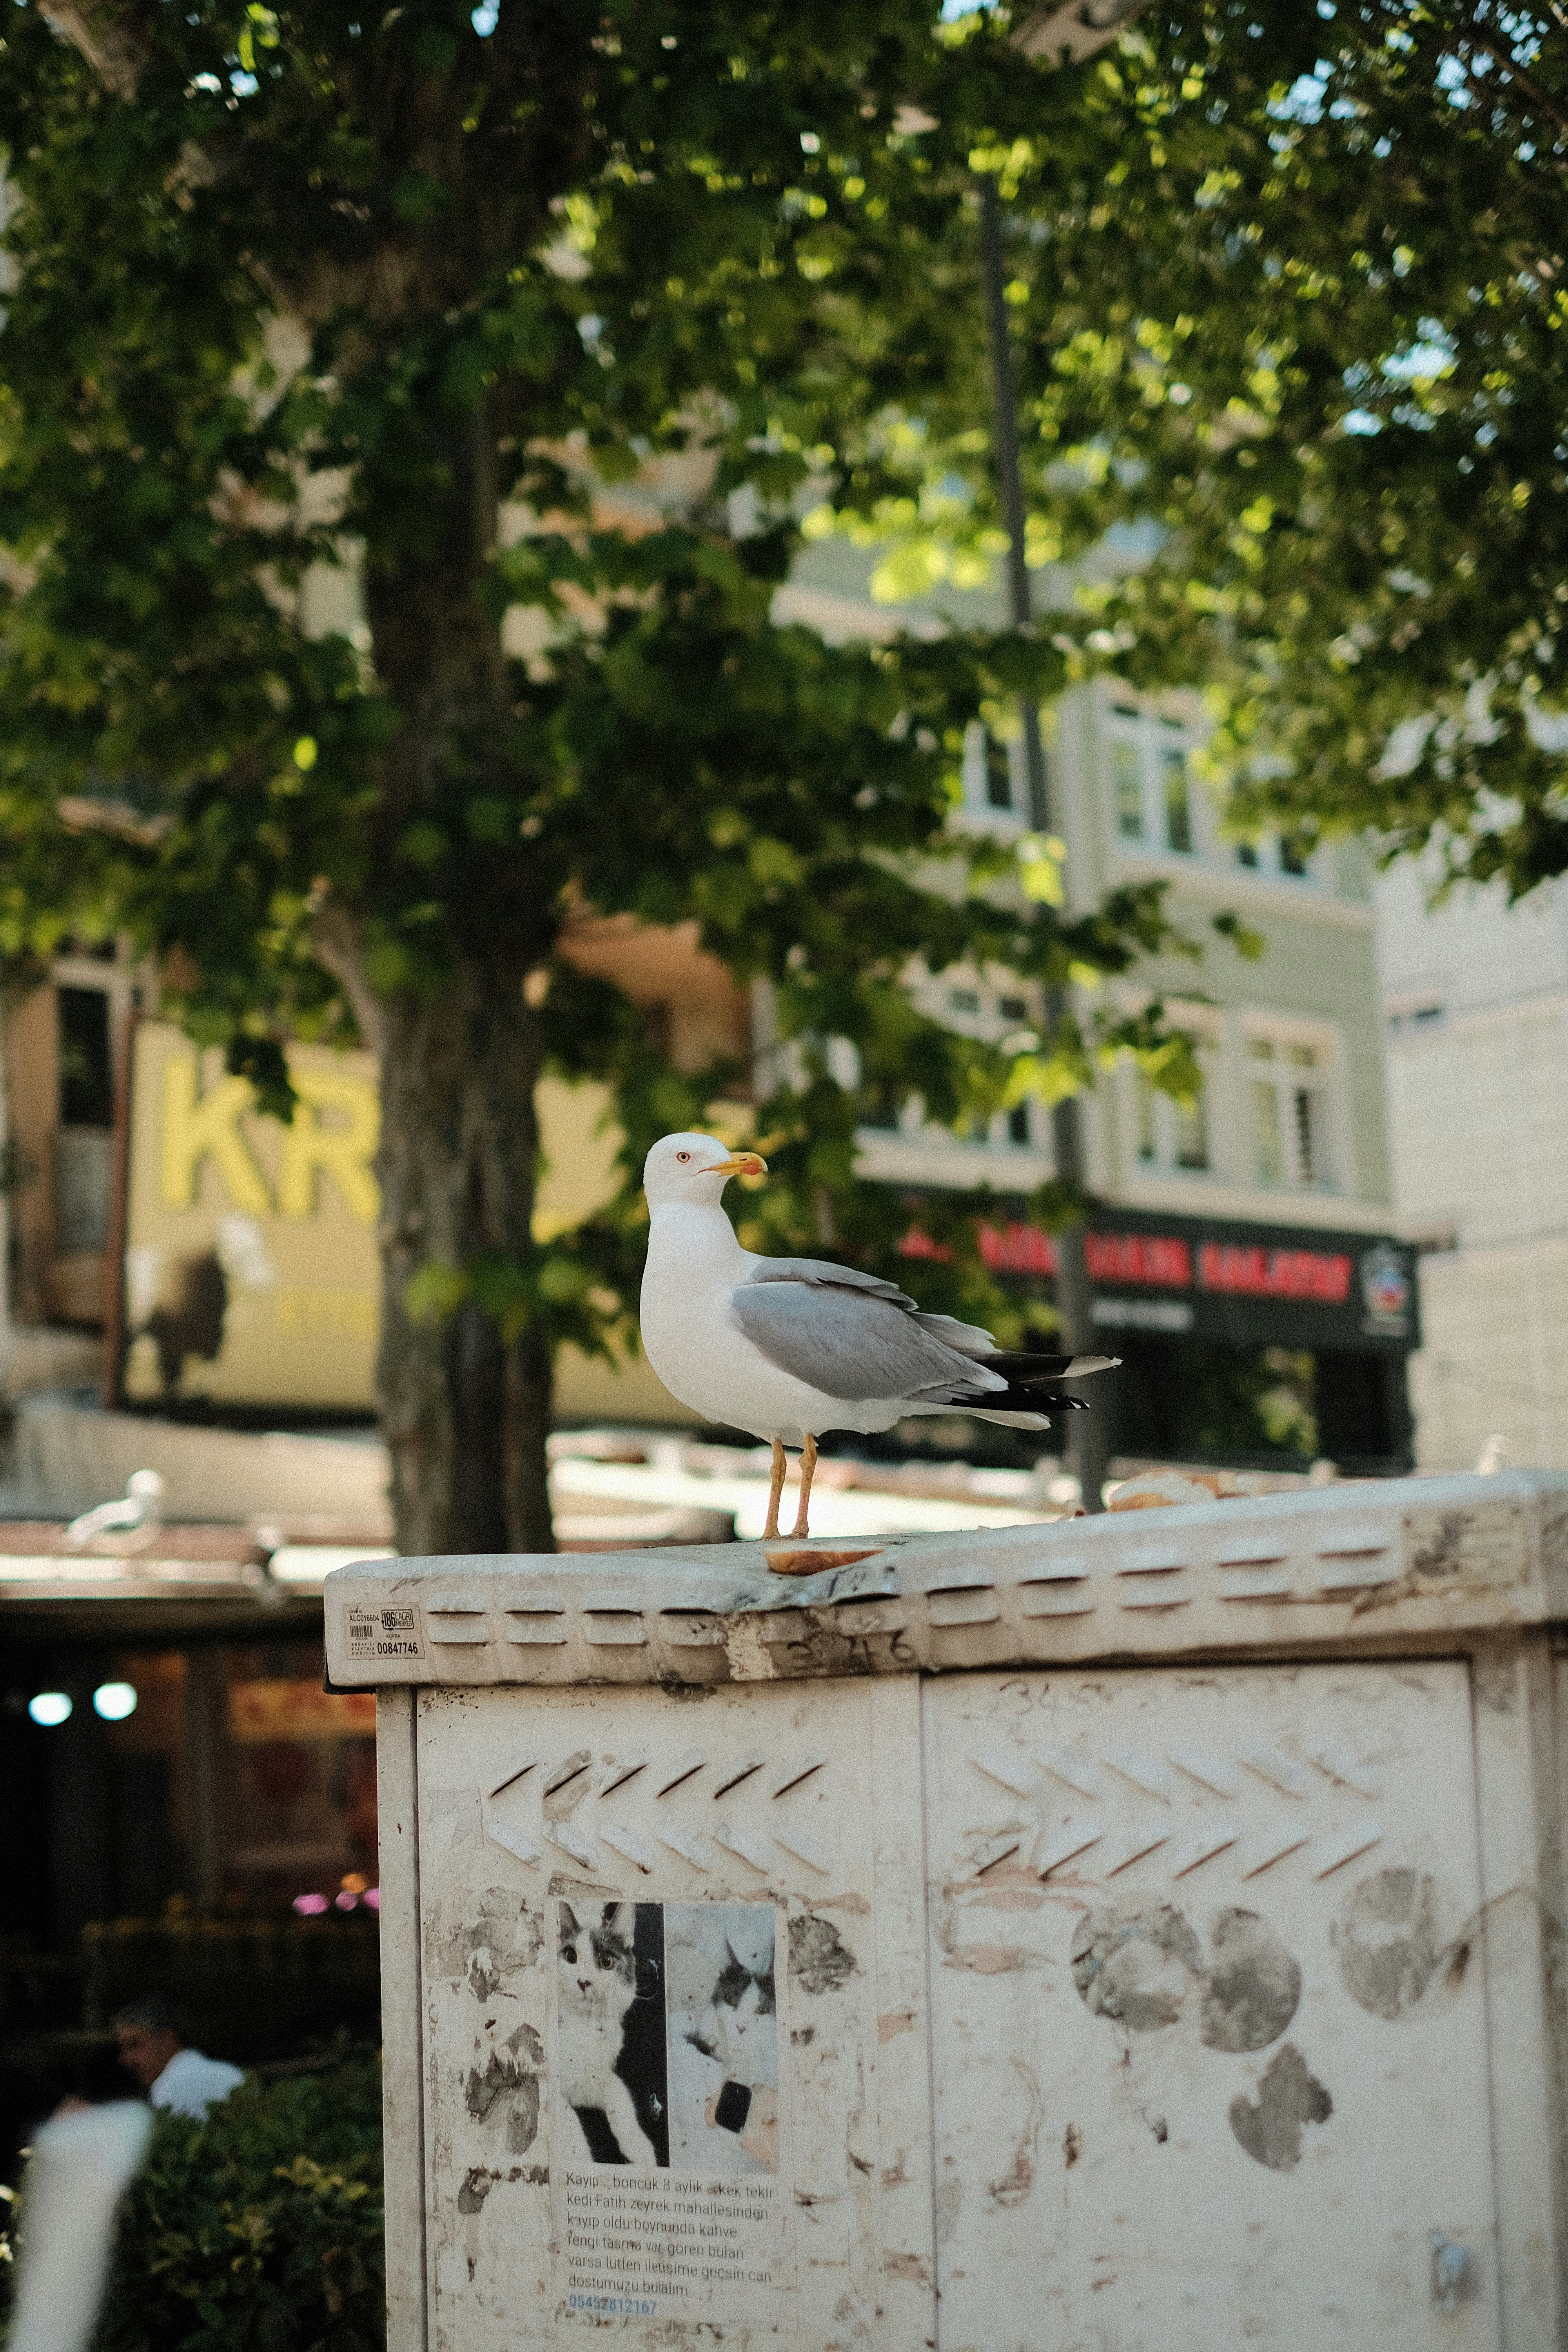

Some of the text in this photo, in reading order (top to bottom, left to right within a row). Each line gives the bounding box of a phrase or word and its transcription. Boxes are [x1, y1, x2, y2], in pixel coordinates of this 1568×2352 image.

[383, 1612, 396, 1627] 186
[377, 1642, 417, 1654] 00847746
[663, 2179, 670, 2189] 8
[675, 2180, 702, 2194] aylık
[746, 2185, 773, 2198] tekir
[567, 2192, 768, 2220] kedi Fatih zeyrek mahallesinden
[567, 2213, 737, 2237] kayıp oldu boynunda kahve
[567, 2235, 599, 2249] rengi
[603, 2237, 641, 2250] tasma
[668, 2241, 704, 2257] gören
[708, 2245, 744, 2259] bulan
[568, 2256, 602, 2269] varsa
[606, 2257, 641, 2272] lütfen
[702, 2266, 745, 2281] geçsin
[749, 2270, 772, 2283] can
[568, 2274, 688, 2296] dostumuzu bulalım
